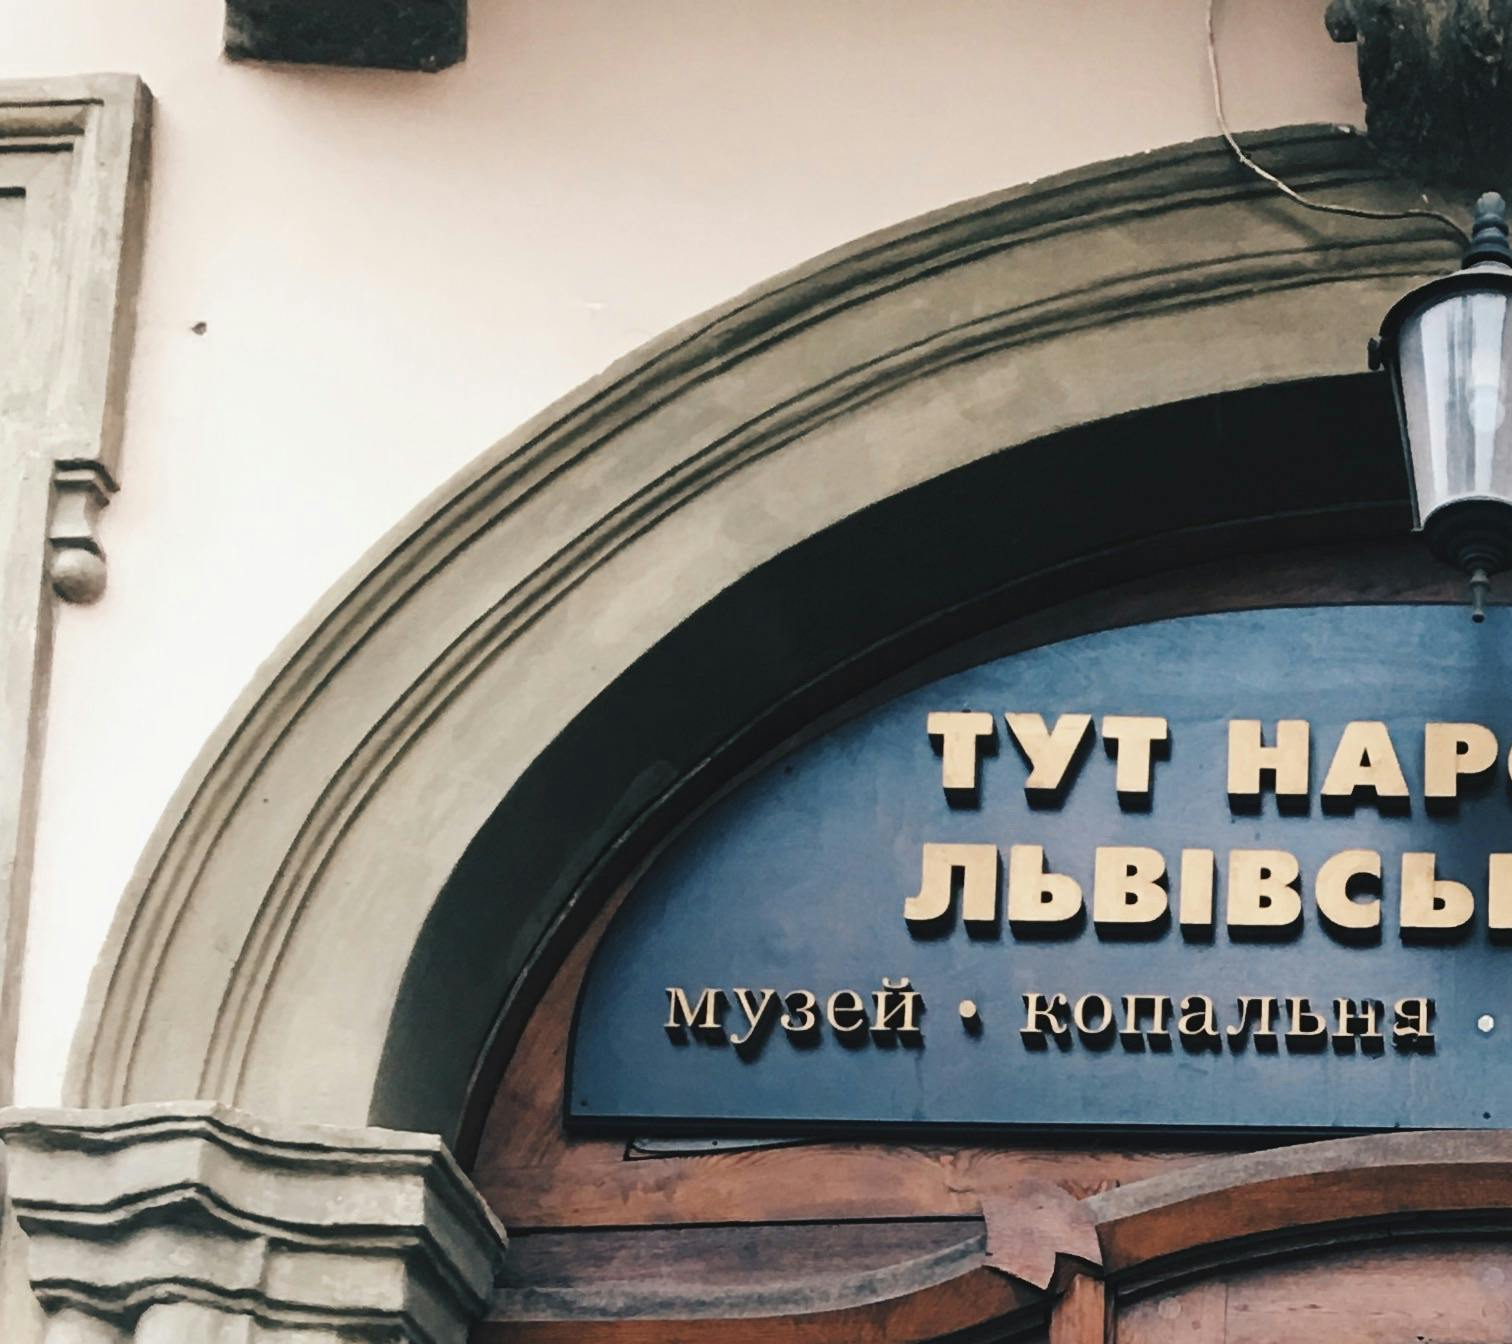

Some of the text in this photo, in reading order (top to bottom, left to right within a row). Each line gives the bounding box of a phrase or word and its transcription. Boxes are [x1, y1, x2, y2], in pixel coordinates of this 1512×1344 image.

[926, 711, 1171, 794] ТУТ
[666, 977, 922, 1044] музей
[1022, 990, 1433, 1038] копальня
